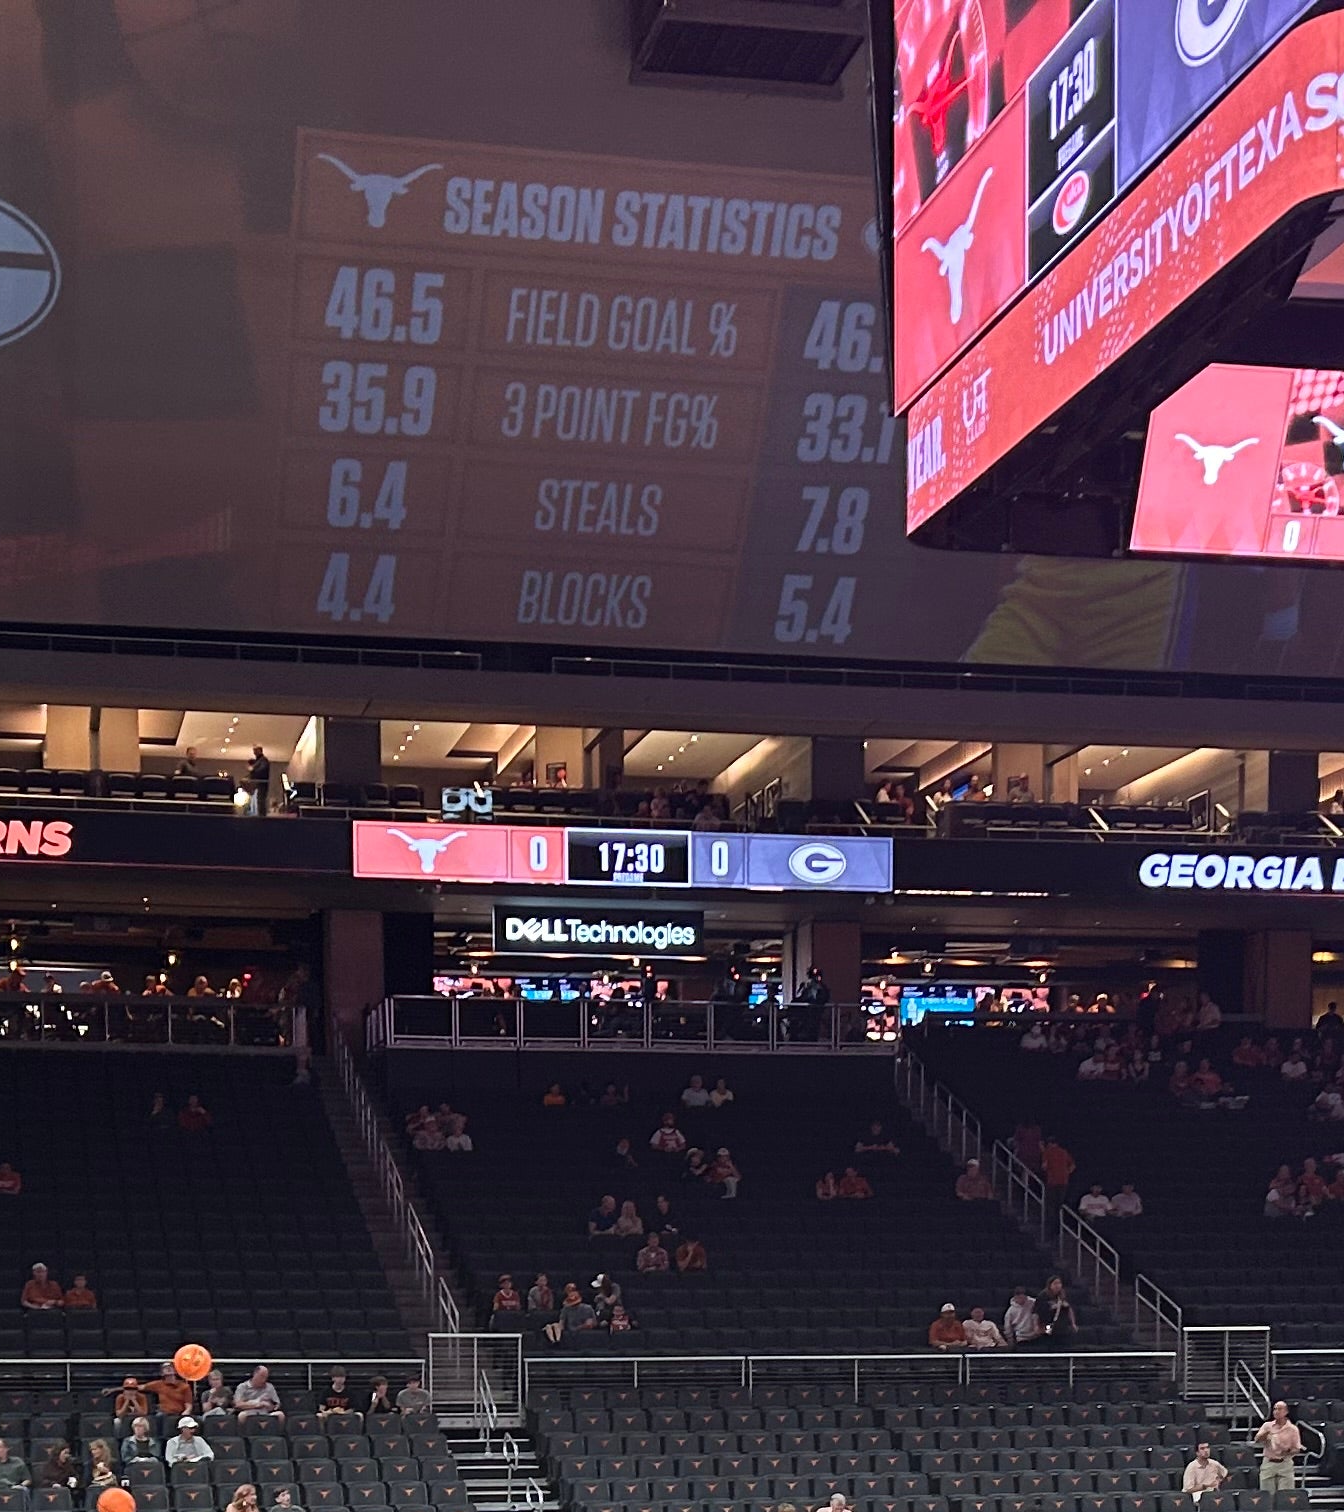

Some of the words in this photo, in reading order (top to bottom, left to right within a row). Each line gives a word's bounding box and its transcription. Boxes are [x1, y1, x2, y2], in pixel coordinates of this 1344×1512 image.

[1049, 37, 1097, 140] 17:30
[444, 177, 604, 244] SEASON
[613, 190, 842, 260] STATISTICS
[325, 266, 446, 345] 46.5
[506, 287, 599, 349] FIELD
[608, 295, 696, 356] GOAL
[709, 303, 738, 358] %
[804, 300, 884, 373] 46.
[318, 360, 437, 437] 35.9
[501, 382, 526, 438] 3
[532, 384, 640, 444] POINT
[645, 393, 718, 450] FG%
[326, 458, 408, 531] 6.4
[535, 478, 662, 538] STEALS
[794, 486, 870, 556] 7.8
[1282, 520, 1301, 553] 0
[317, 552, 397, 624] 4.4
[517, 569, 652, 631] BLOCKS
[773, 574, 857, 645] 5.4
[529, 836, 548, 872] 0
[598, 842, 665, 873] 17:30
[711, 840, 729, 877] 0
[1139, 853, 1323, 891] GEORGIA
[506, 917, 568, 943] DELL
[568, 918, 696, 950] Technologies
